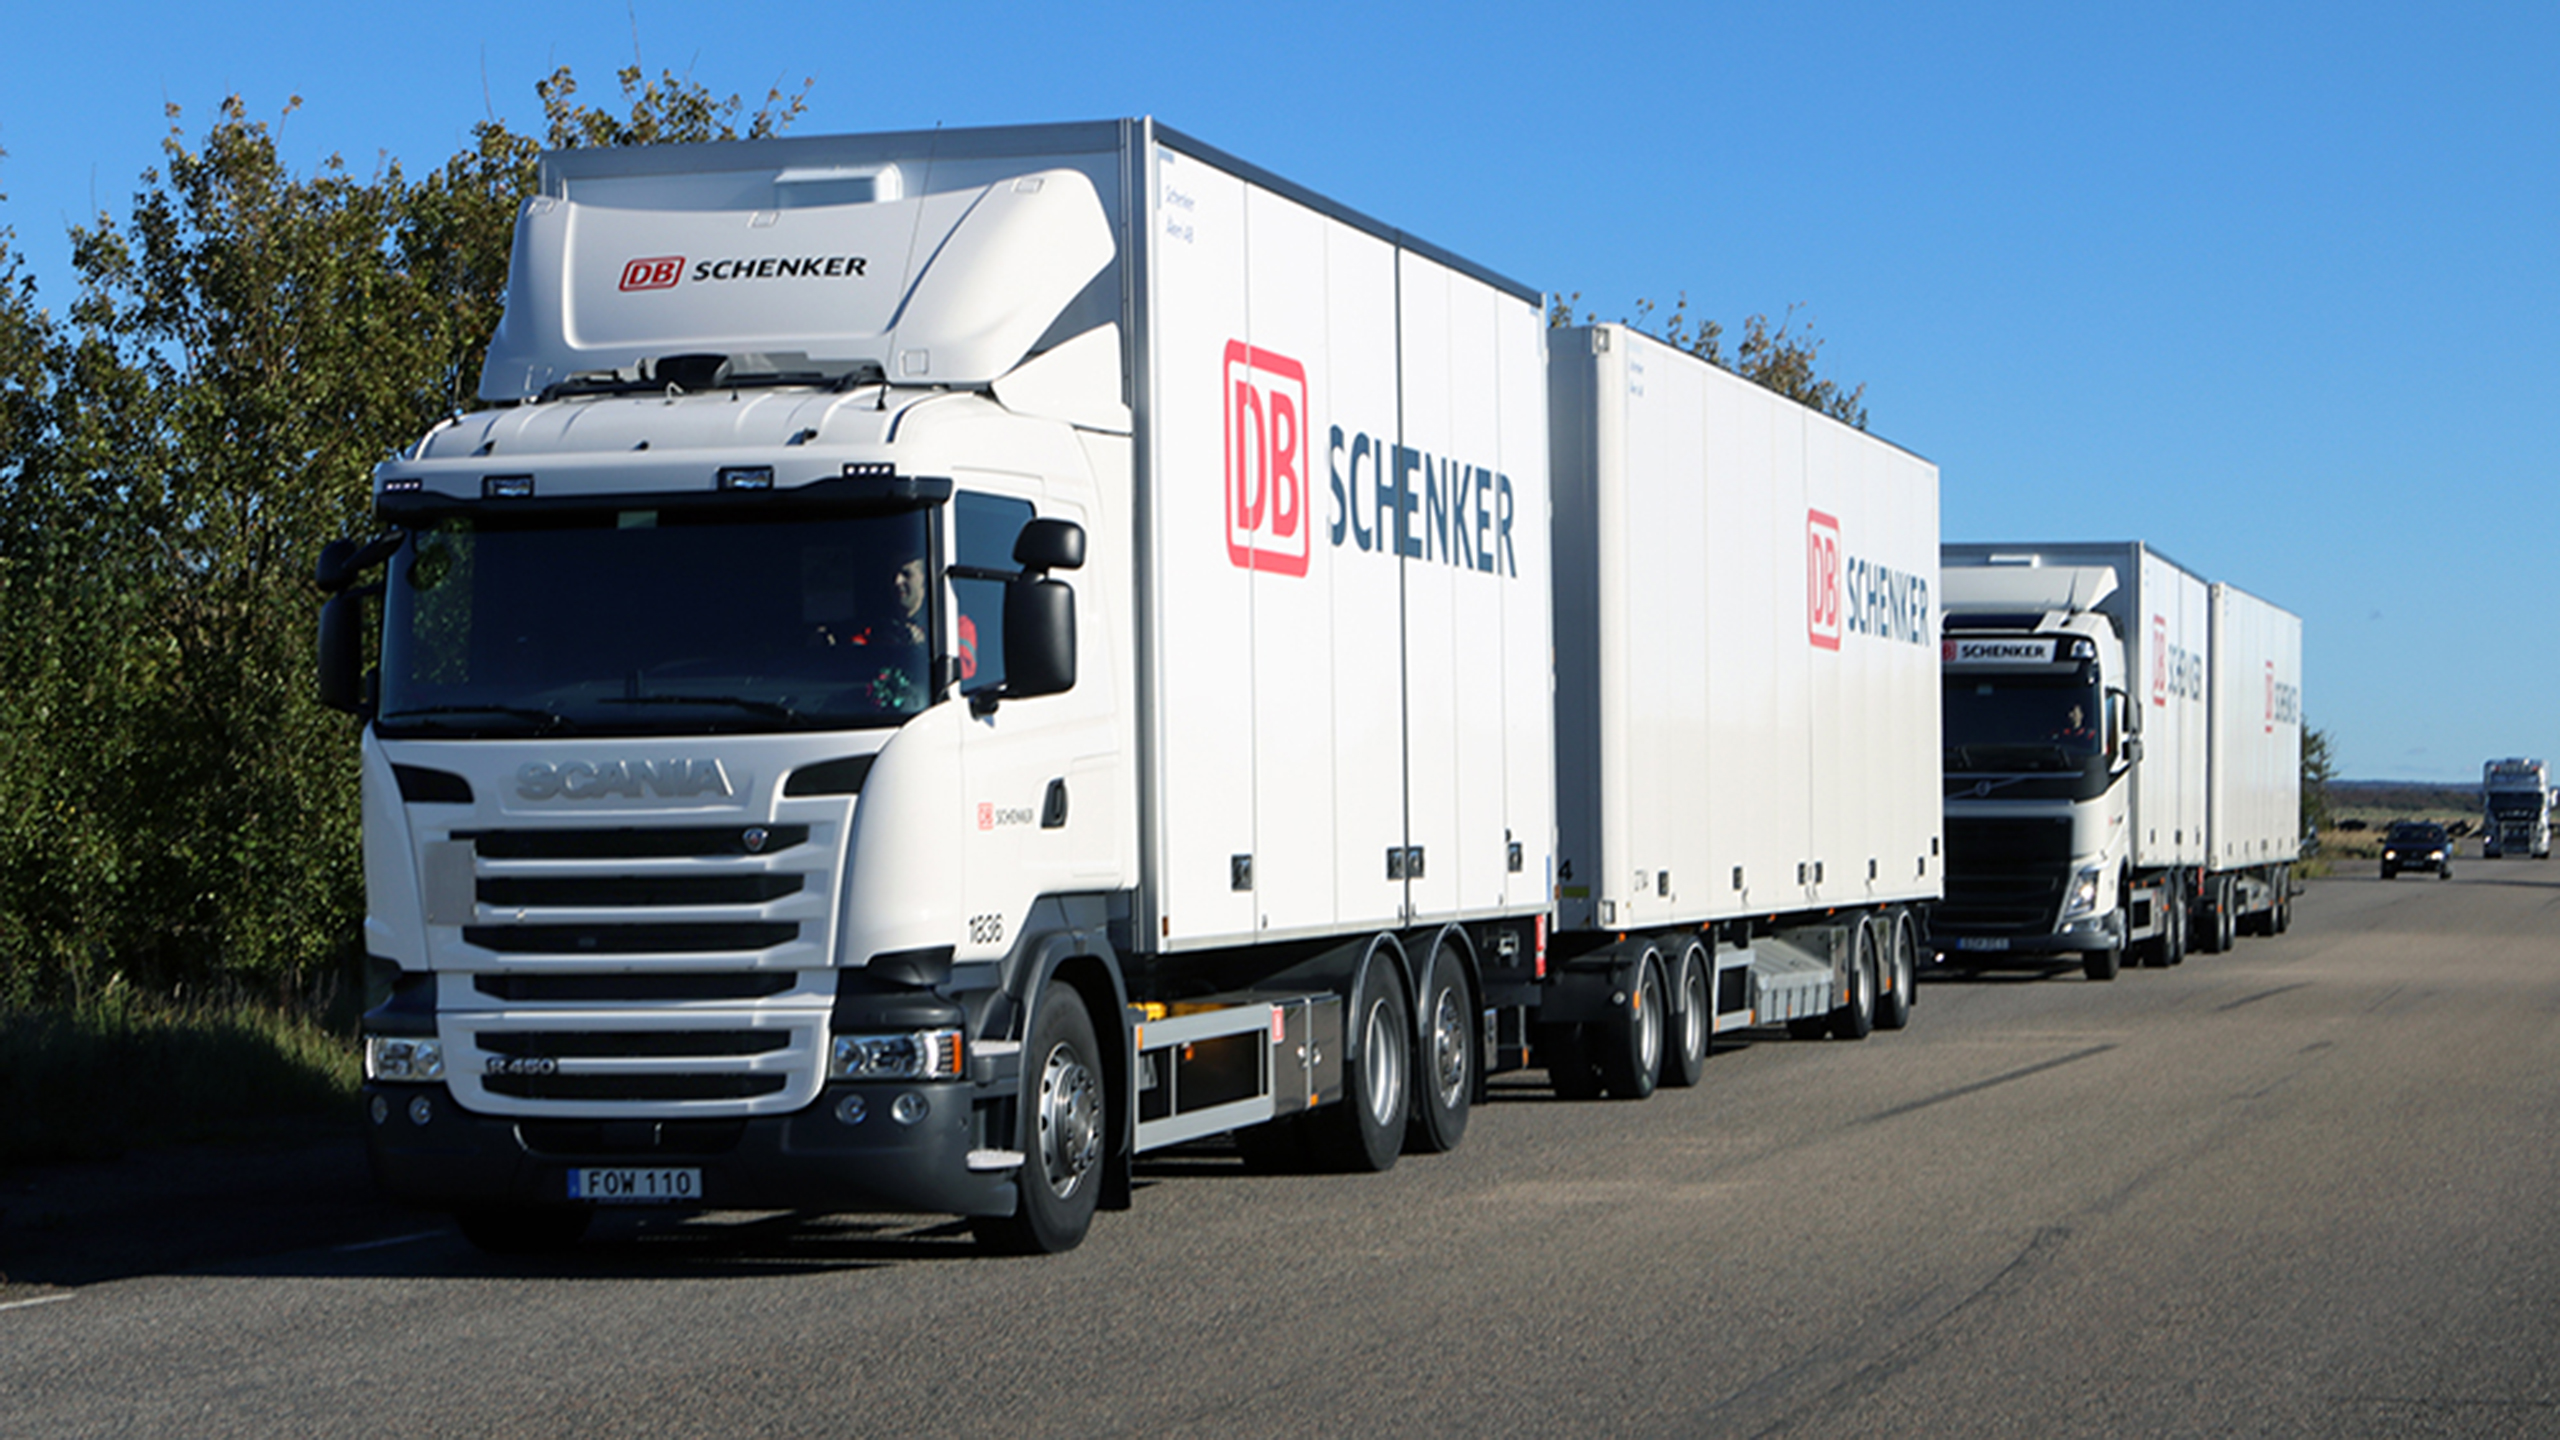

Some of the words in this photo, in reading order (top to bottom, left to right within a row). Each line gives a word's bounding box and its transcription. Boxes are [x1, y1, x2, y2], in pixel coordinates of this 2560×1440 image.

[627, 261, 676, 286] DB
[692, 257, 867, 281] SCHENKER
[1233, 376, 1301, 541] DB
[1326, 424, 1517, 578] SCHENKER
[1811, 529, 1838, 631] DB
[1847, 556, 1930, 647] SCHENKER
[1962, 644, 2046, 659] SCHENKER
[516, 758, 734, 800] SCANIA
[969, 913, 1004, 944] 1836
[588, 1172, 636, 1195] FOW
[645, 1171, 691, 1195] 110
